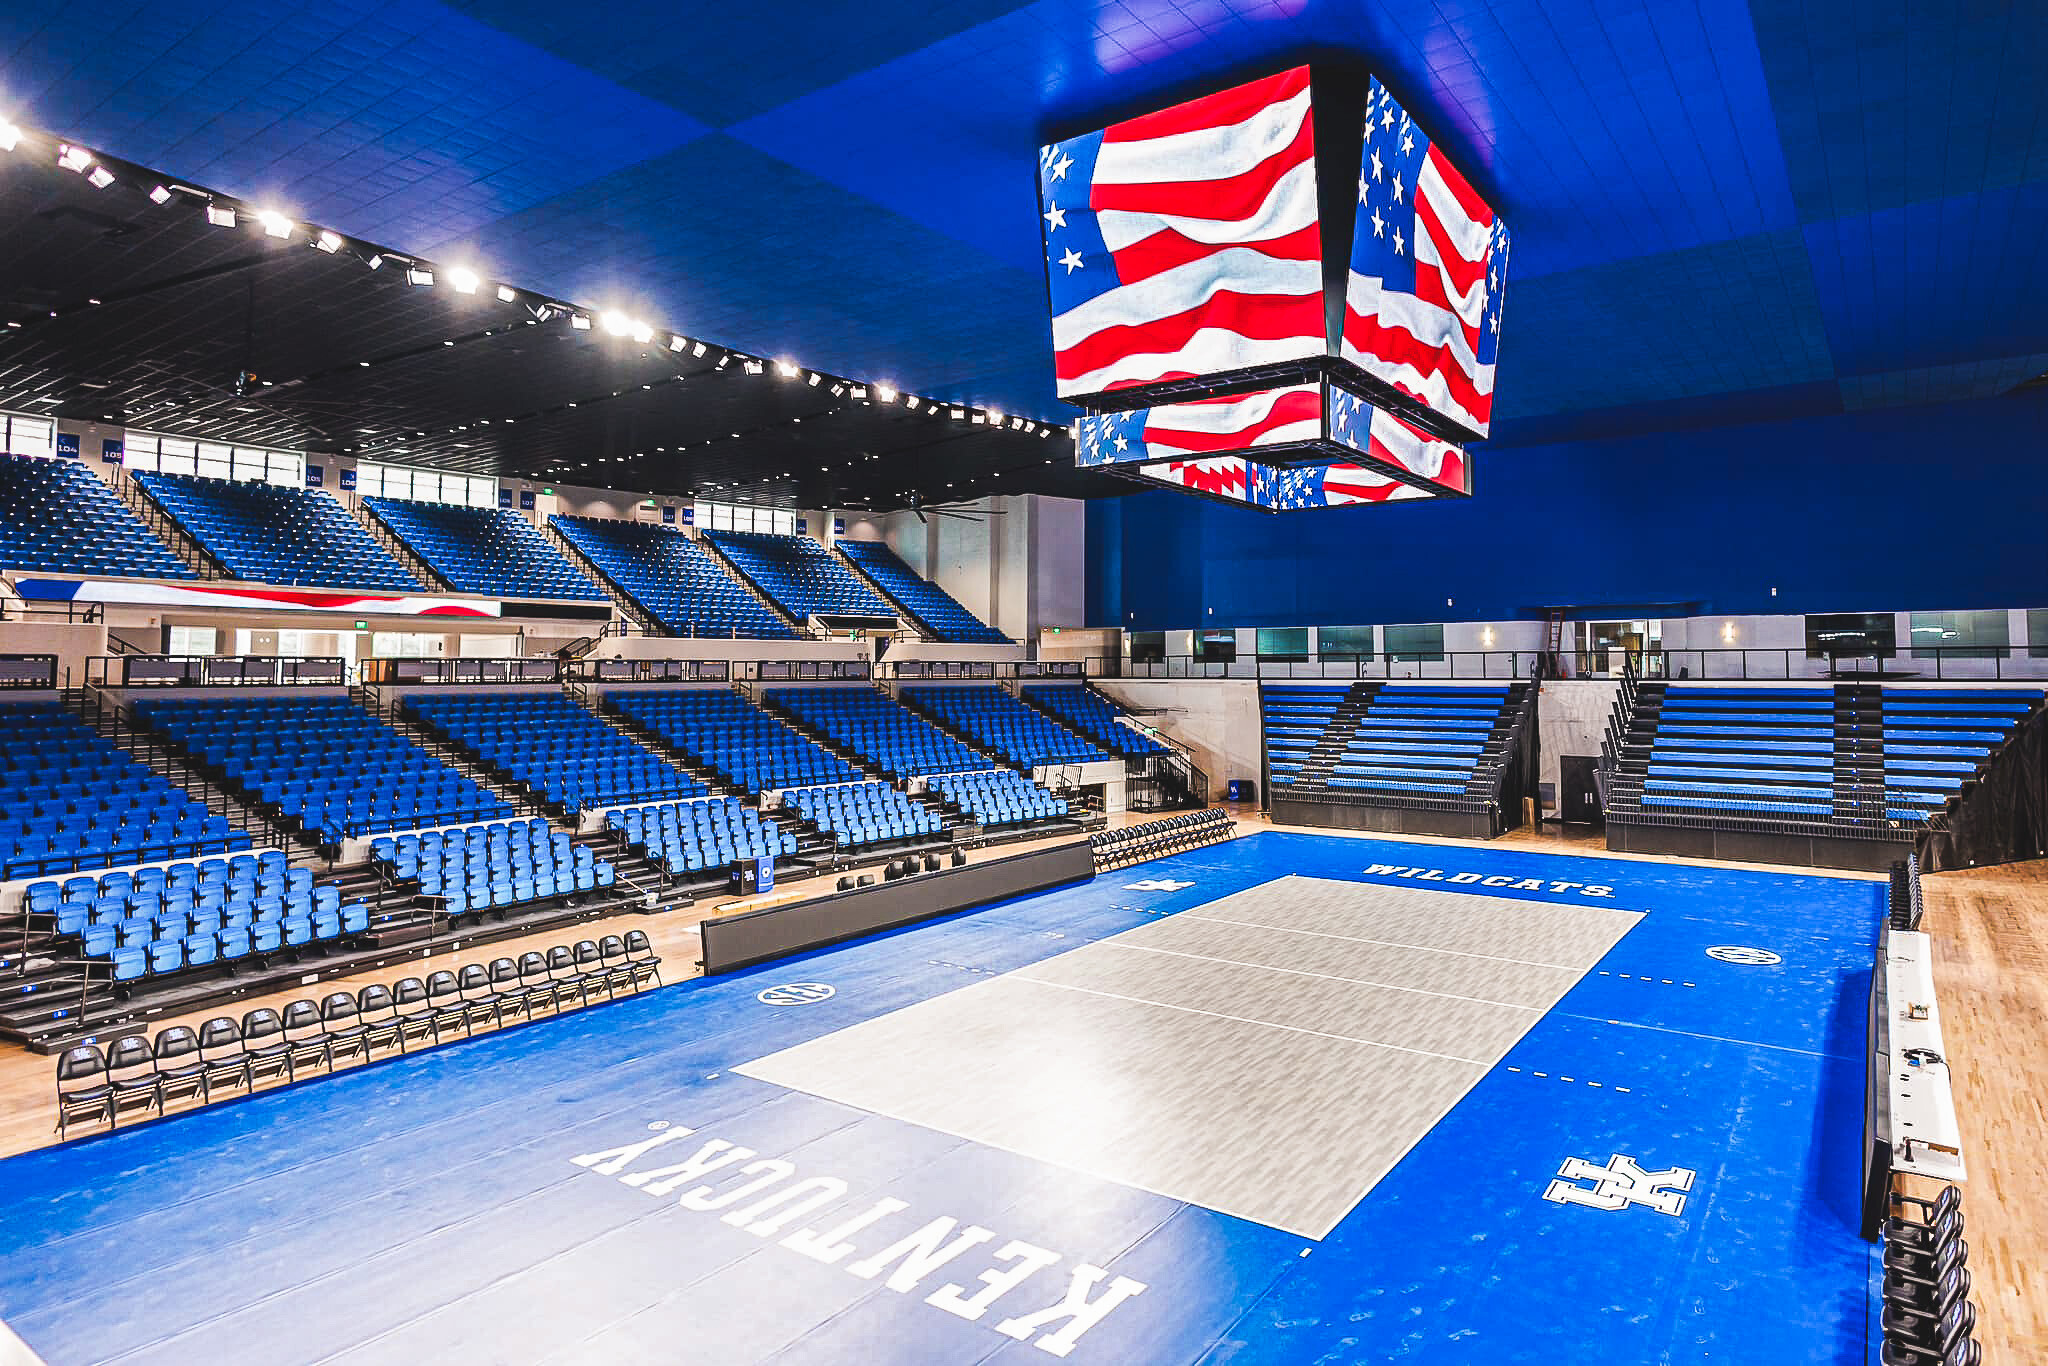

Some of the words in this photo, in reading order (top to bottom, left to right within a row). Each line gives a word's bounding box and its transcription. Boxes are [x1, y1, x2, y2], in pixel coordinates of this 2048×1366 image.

[1363, 864, 1613, 897] WILDCATS
[1542, 1152, 1697, 1216] UK
[568, 1126, 1148, 1358] KENTUCKY
